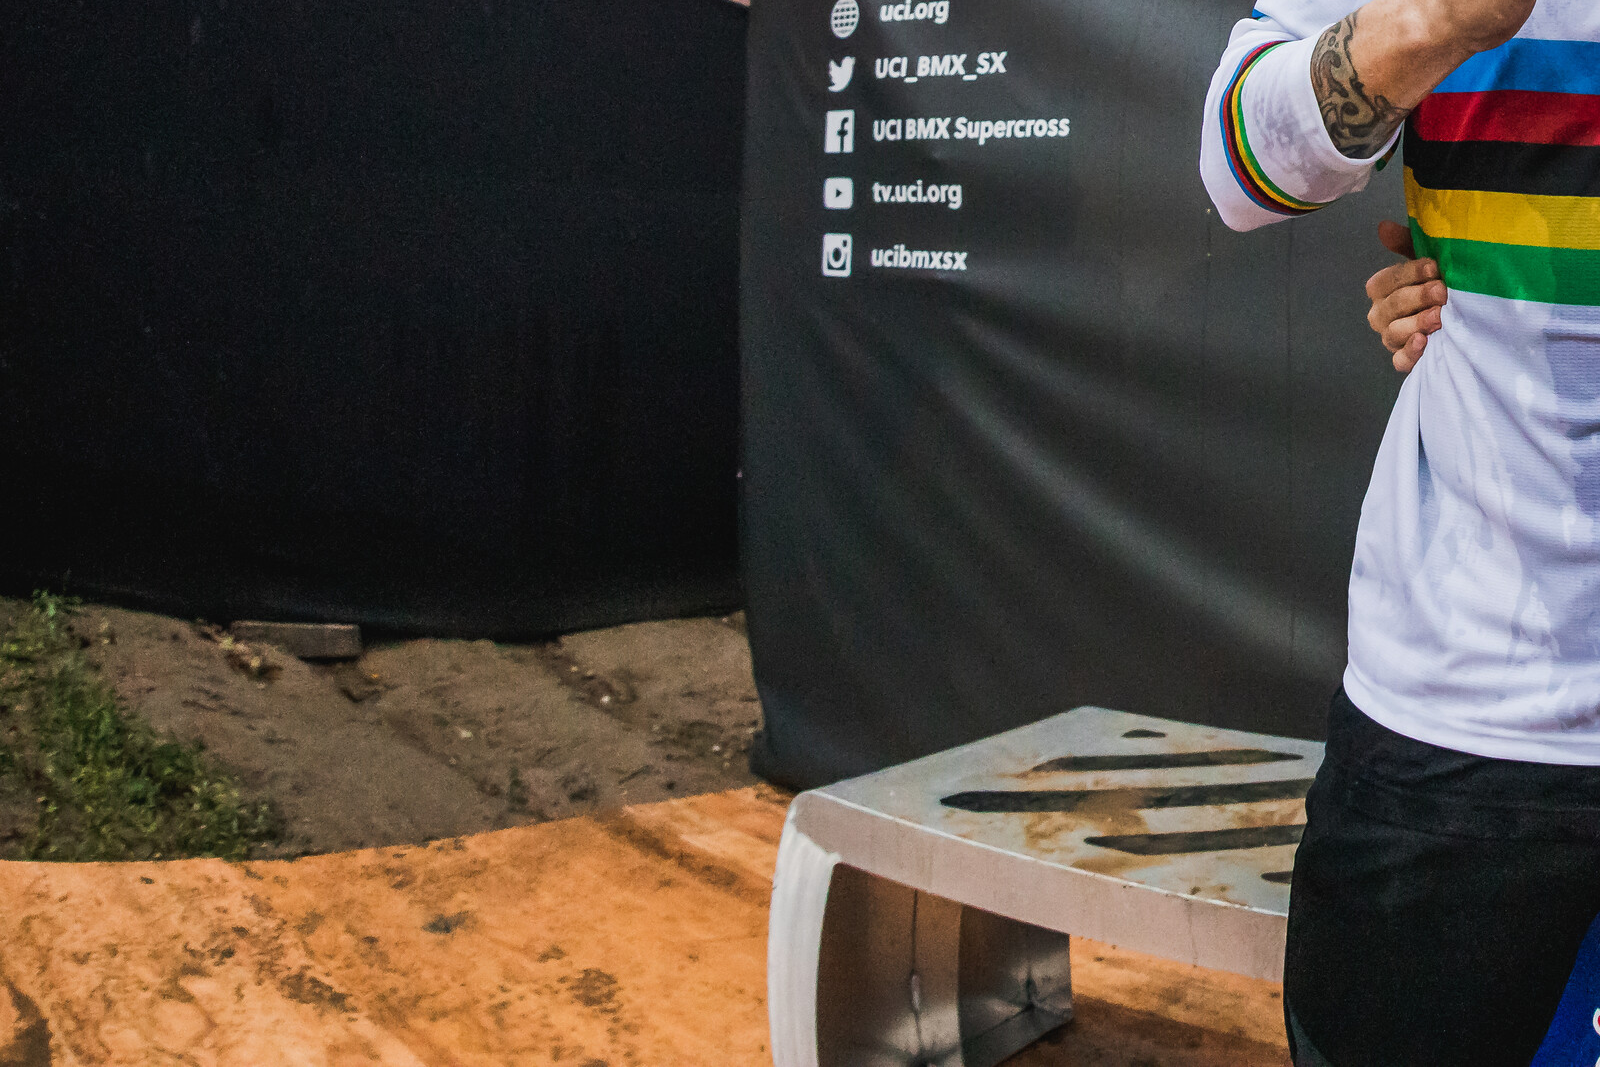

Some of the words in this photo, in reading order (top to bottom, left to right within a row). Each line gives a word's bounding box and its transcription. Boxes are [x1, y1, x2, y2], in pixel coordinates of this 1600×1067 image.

[875, 51, 1008, 82] UCI_BMX_SX
[873, 118, 902, 141] UCI
[905, 117, 951, 141] BMX
[954, 115, 1070, 142] Supercross
[872, 180, 963, 208] tv.uci.org
[871, 246, 968, 272] ucibmxsx
